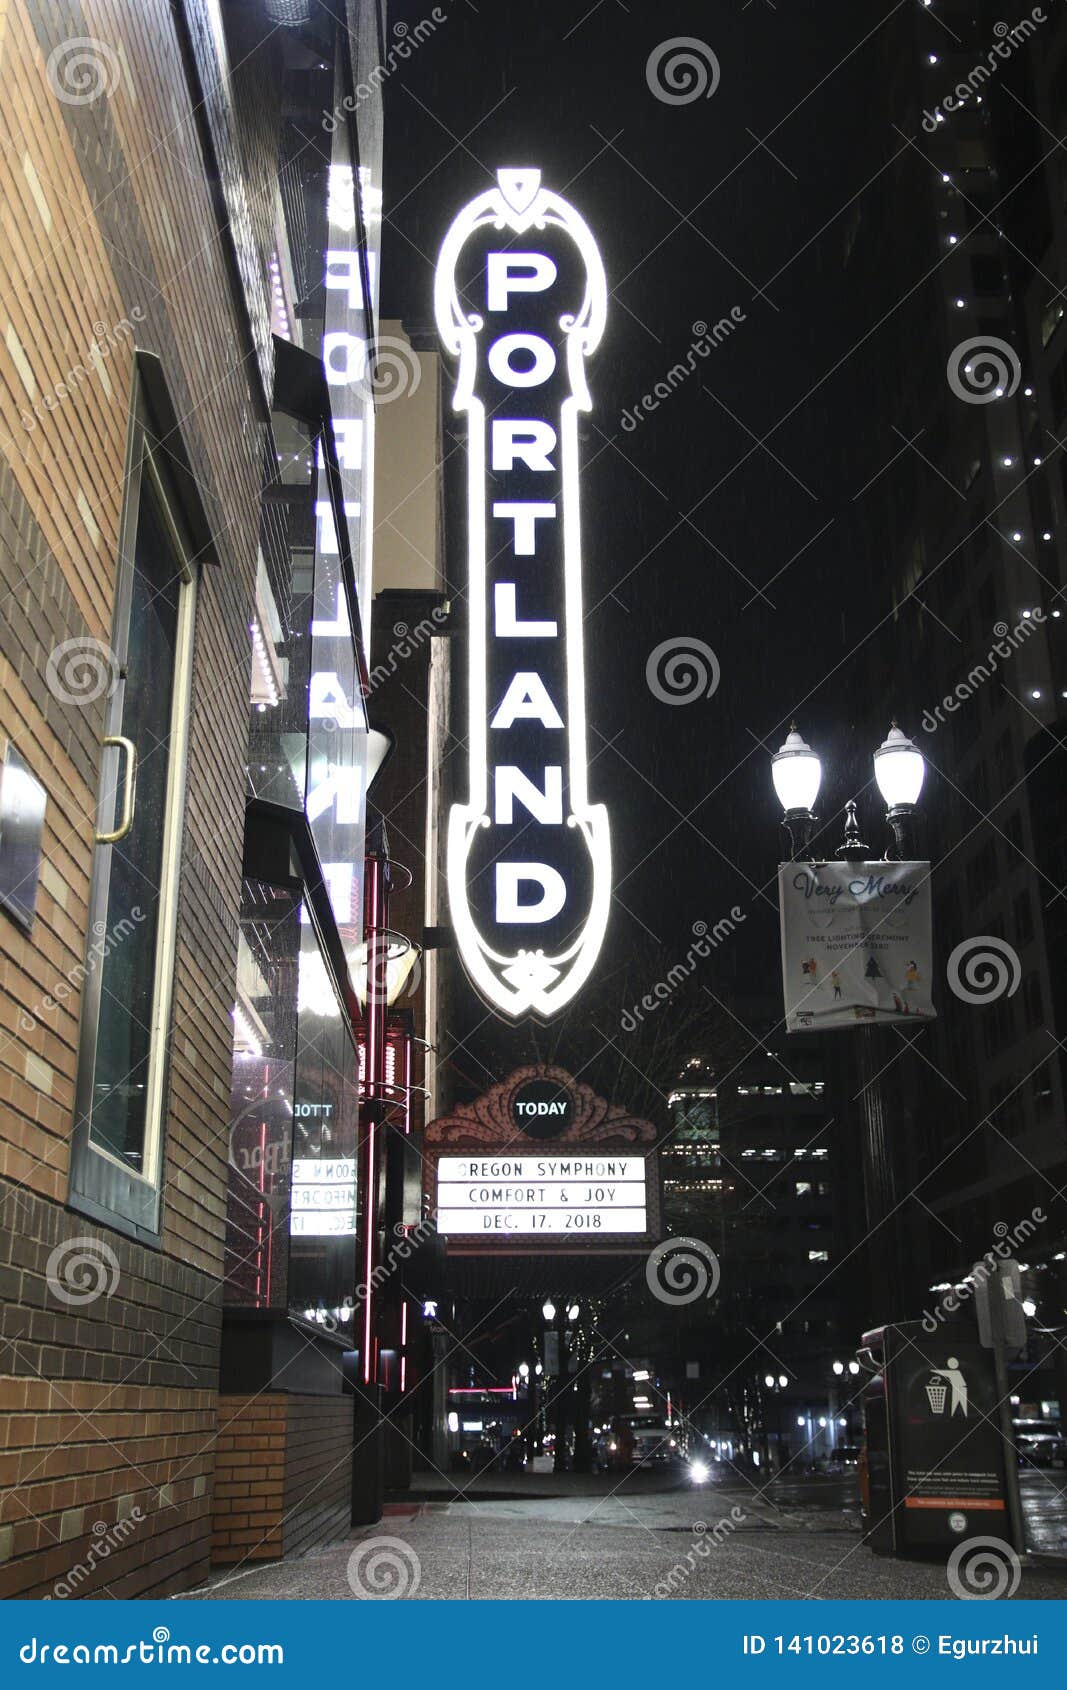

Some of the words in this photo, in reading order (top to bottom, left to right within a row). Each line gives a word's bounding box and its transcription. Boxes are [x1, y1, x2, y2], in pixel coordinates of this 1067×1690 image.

[487, 252, 567, 924] PORTLAND
[793, 872, 845, 904] Very
[849, 875, 920, 905] Merry
[516, 1102, 568, 1116] TODAY
[460, 1163, 523, 1177] OREGON
[537, 1162, 628, 1177] SYMPHONY
[469, 1188, 546, 1203] COMFORT
[560, 1189, 569, 1202] &
[584, 1188, 616, 1202] JOY
[483, 1215, 518, 1229] DEC.
[565, 1214, 602, 1229] 2018
